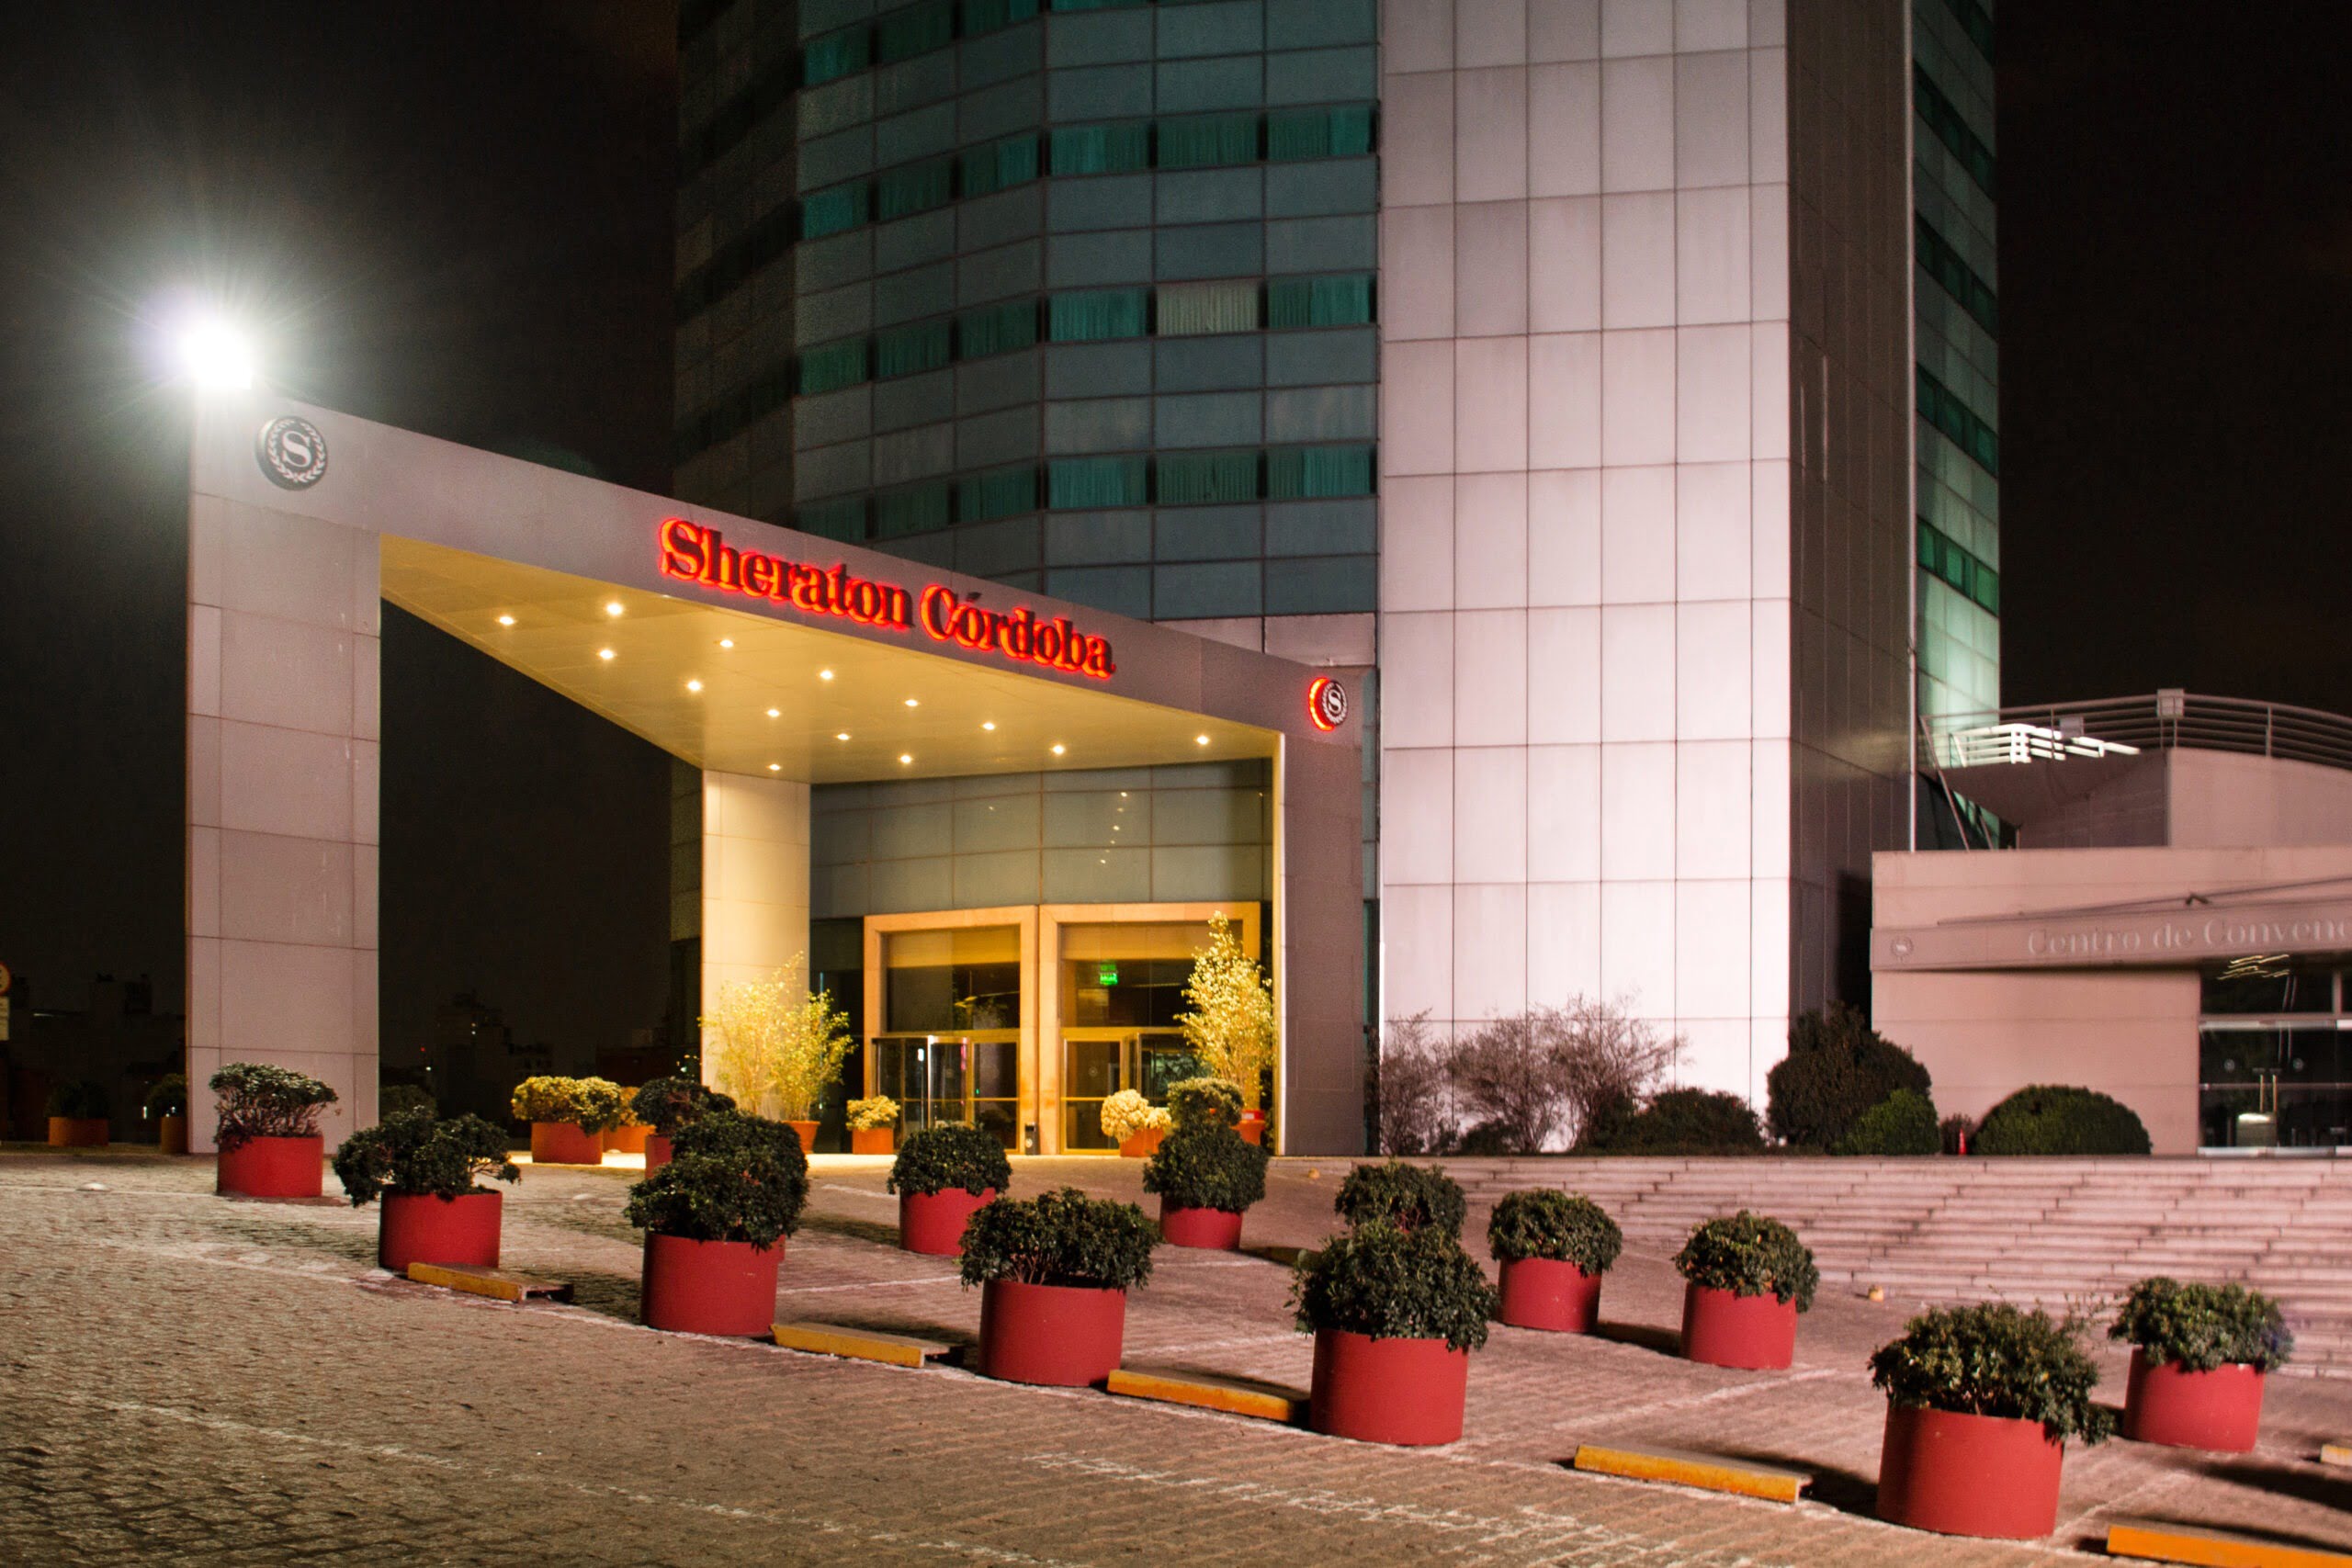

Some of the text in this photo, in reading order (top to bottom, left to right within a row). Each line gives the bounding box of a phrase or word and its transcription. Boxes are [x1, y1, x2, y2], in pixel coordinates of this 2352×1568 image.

[660, 517, 1115, 678] Sheraton Córdoba
[2028, 927, 2141, 956] Centro
[2153, 922, 2192, 948] de
